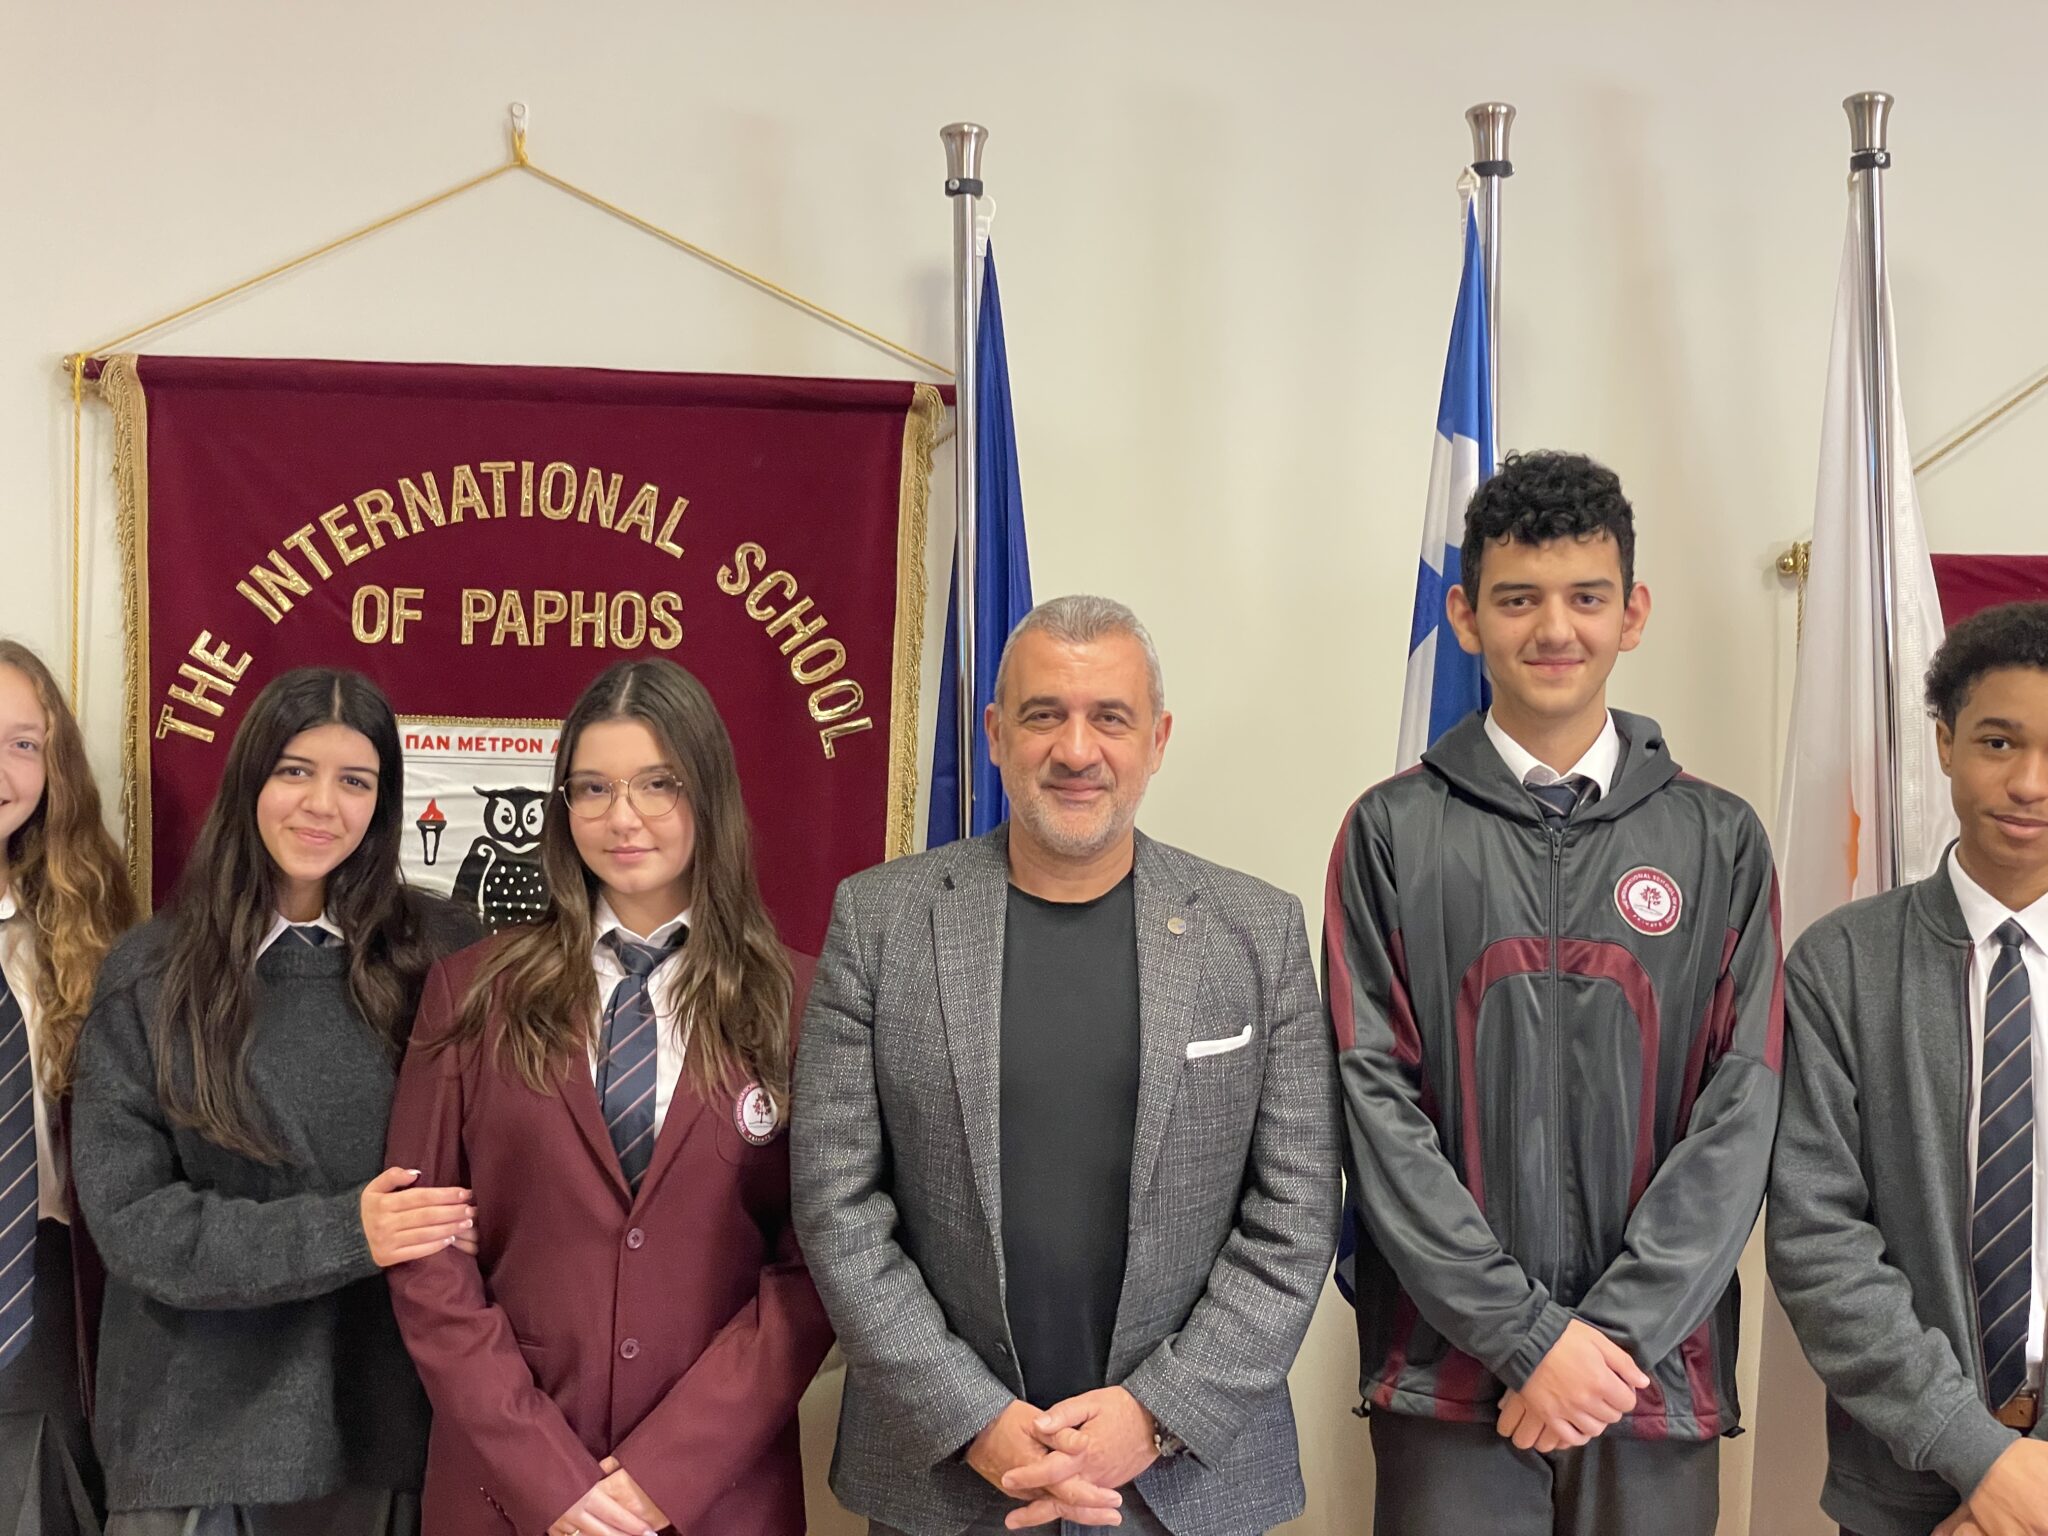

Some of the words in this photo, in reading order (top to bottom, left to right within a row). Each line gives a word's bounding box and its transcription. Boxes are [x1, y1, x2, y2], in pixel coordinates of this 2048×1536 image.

[155, 630, 252, 743] THE
[236, 460, 690, 624] INTERNATIONAL
[717, 542, 873, 760] SCHOOL
[352, 585, 424, 644] OF
[461, 589, 684, 649] PAPHOS
[405, 734, 450, 751] ΠΑΝ
